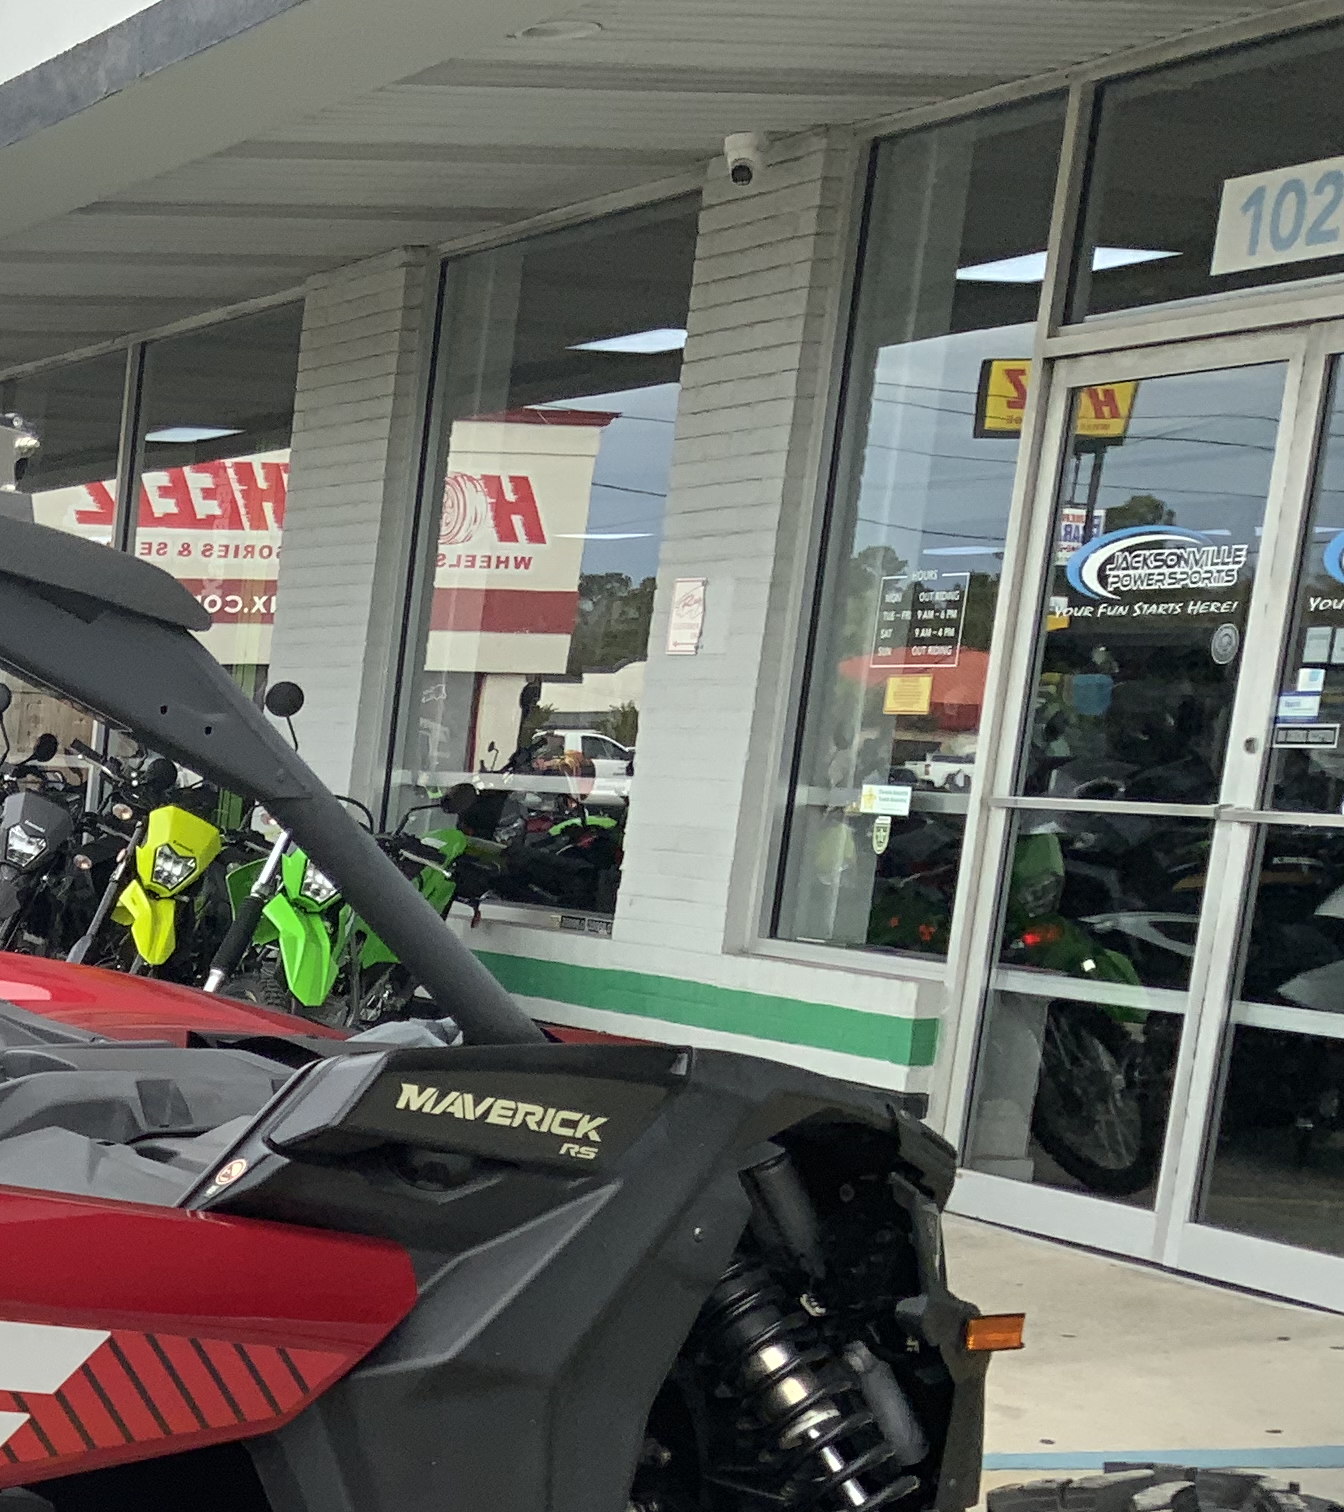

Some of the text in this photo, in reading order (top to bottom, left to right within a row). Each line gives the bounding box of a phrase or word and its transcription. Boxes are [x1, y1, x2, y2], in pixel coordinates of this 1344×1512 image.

[1106, 545, 1248, 573] JACKSONVILLE
[1108, 567, 1239, 591] POWERSPORTS
[396, 1083, 610, 1142] MAVERICK
[559, 1143, 598, 1160] RS
